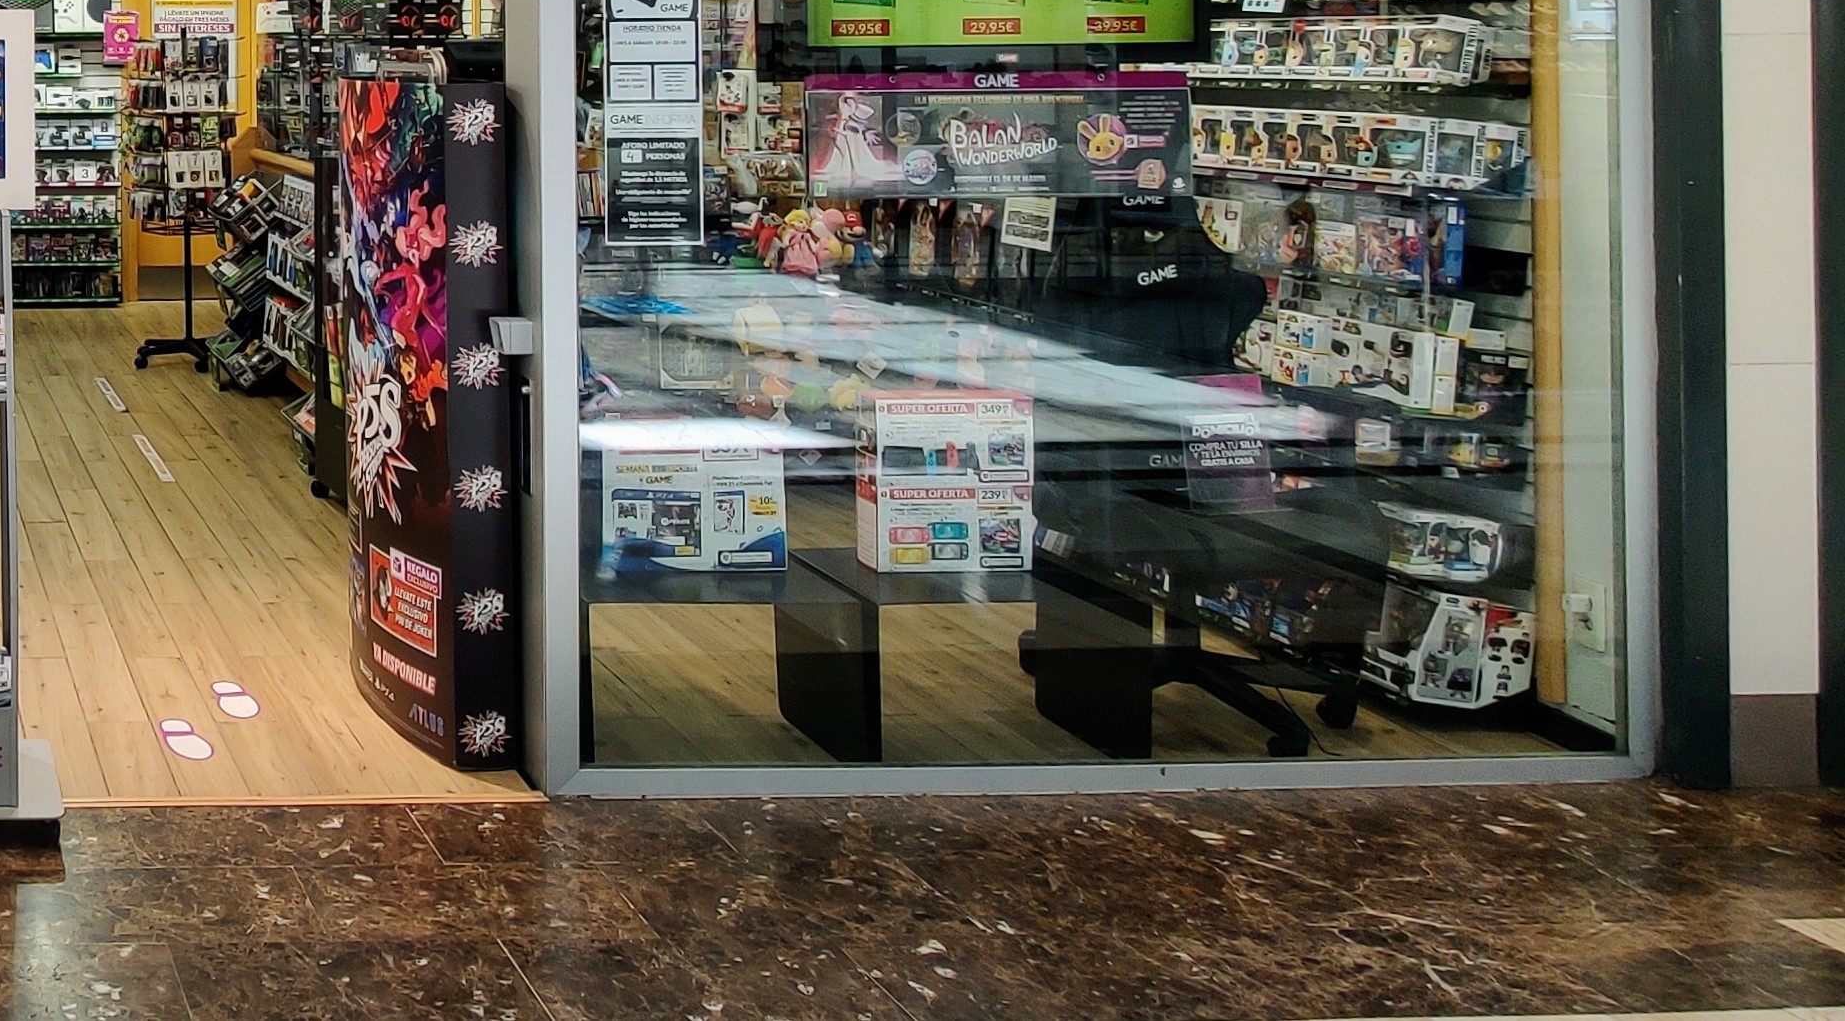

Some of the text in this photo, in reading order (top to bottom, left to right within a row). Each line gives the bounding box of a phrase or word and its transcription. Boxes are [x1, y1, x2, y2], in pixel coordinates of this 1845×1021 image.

[660, 4, 688, 12] GAME
[158, 24, 176, 33] SIN
[838, 23, 882, 35] 49,95€
[970, 21, 1014, 34] 29,95€
[1095, 20, 1138, 31] 39,95€
[974, 74, 1019, 88] GAME
[610, 115, 644, 125] GAME
[1137, 264, 1178, 287] GAME
[891, 404, 968, 413] SUPER OFERTA
[356, 381, 400, 459] P5S
[1149, 454, 1183, 467] GAM
[646, 476, 673, 484] GAME
[894, 489, 969, 498] SUPER OFERTA
[406, 561, 438, 583] REGALO
[406, 573, 438, 593] EXCLUSIVO
[417, 596, 432, 611] ESTE
[373, 641, 382, 665] YA
[382, 650, 436, 697] DISPONIBLE
[409, 703, 446, 738] ATLUS
